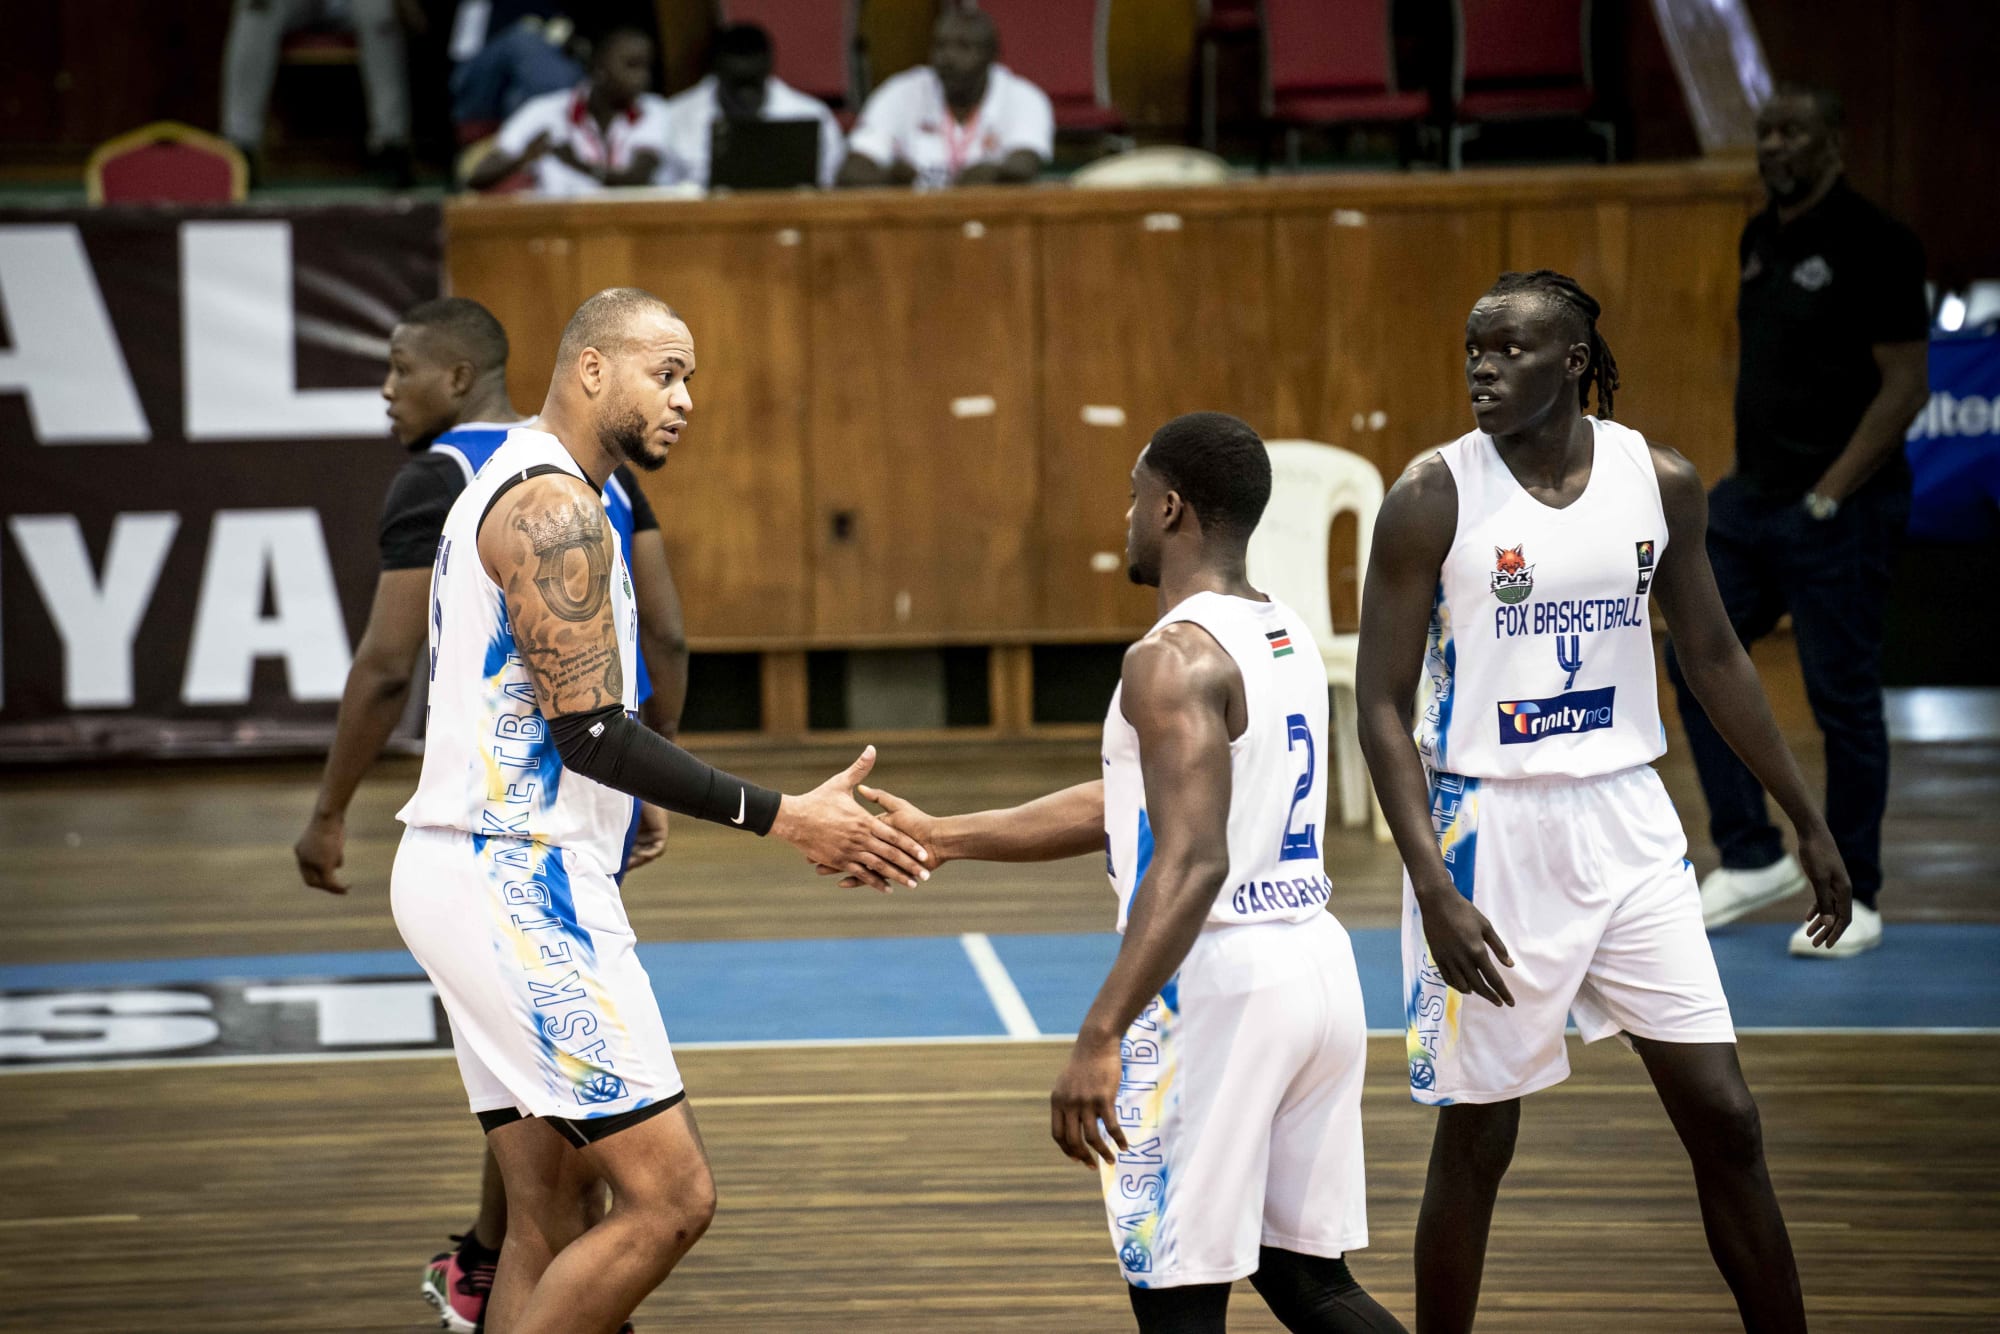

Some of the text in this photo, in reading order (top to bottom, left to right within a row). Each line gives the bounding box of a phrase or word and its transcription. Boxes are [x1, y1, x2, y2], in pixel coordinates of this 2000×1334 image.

[0, 507, 353, 710] YA
[1496, 596, 1642, 639] FOX BASKETBALL
[1556, 634, 1583, 690] 4
[1279, 713, 1319, 861] 2
